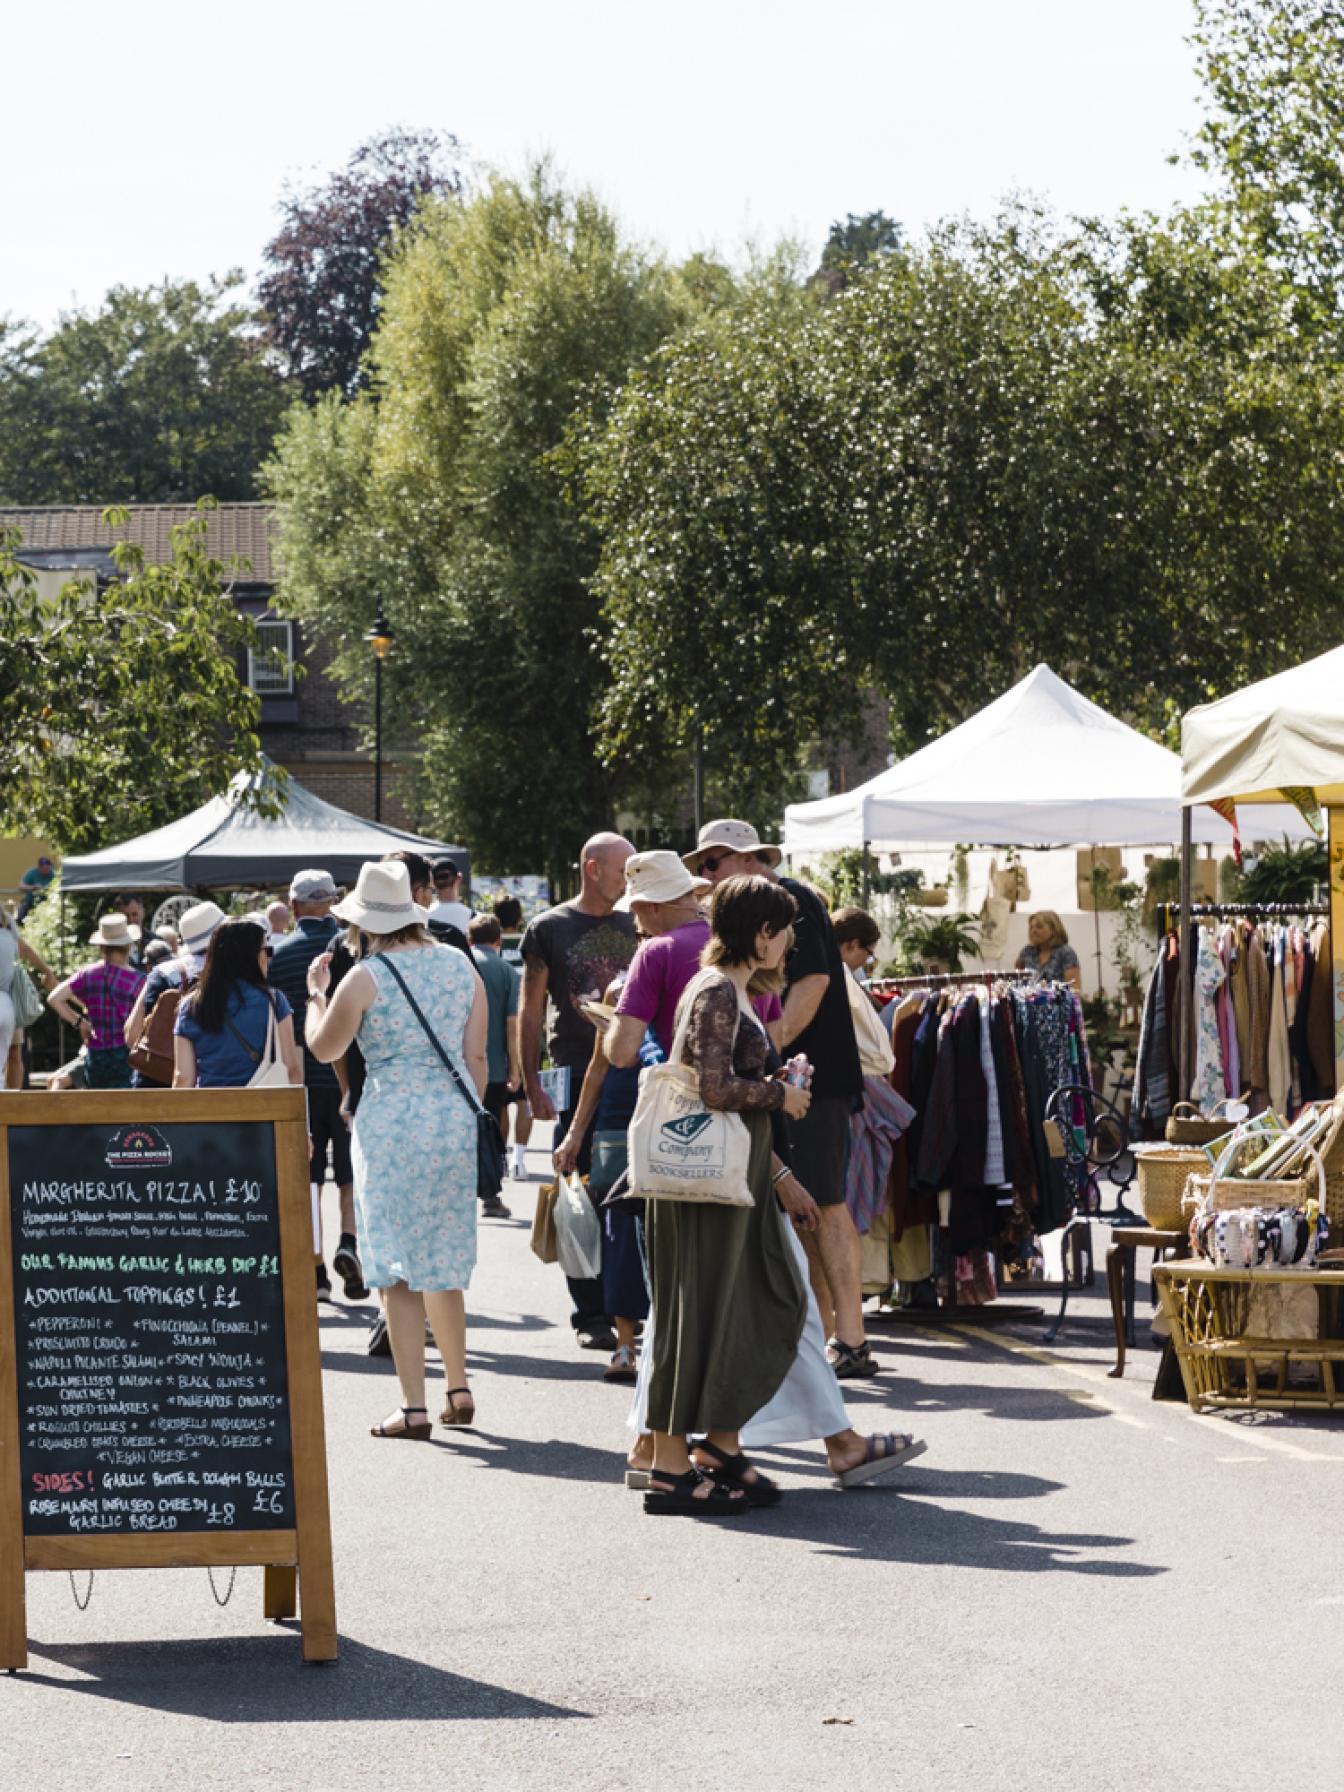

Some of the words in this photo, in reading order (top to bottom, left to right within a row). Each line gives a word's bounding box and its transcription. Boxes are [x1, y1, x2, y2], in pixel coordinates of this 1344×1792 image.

[658, 1141, 714, 1162] Company
[649, 1165, 725, 1179] BOOKSELLERS
[22, 1180, 141, 1204] MARGHERITA
[146, 1180, 217, 1206] PIZZA!
[225, 1178, 261, 1204] £10
[21, 1254, 55, 1270] OUR
[57, 1253, 115, 1271] FAMOUS
[119, 1256, 169, 1273] GARLIC
[187, 1257, 226, 1274] HERB
[232, 1257, 257, 1274] DIP
[257, 1254, 279, 1277] £1
[24, 1286, 121, 1308] ADDITIONAL
[123, 1285, 207, 1308] TOPPINGS!
[213, 1285, 241, 1308] £1
[37, 1317, 101, 1330] PEPPERONI
[93, 1337, 128, 1350] CRUDO
[173, 1334, 217, 1346] SALAMI
[34, 1356, 73, 1370] NAPOLI
[75, 1355, 121, 1369] PICANTE
[122, 1355, 157, 1369] SALAMI
[175, 1353, 204, 1368] SPICY
[36, 1375, 113, 1388] CARAMELISED
[118, 1375, 153, 1387] ONION
[178, 1375, 211, 1389] BLACK
[216, 1375, 254, 1388] OLIVES
[177, 1395, 233, 1408] PINEAPPLE
[238, 1395, 276, 1409] CHUNKS
[35, 1404, 57, 1417] SUN
[61, 1403, 94, 1417] DRIED
[84, 1420, 126, 1433] CHILLIES
[182, 1434, 216, 1449] EXTRA
[220, 1435, 261, 1448] CHEESE
[106, 1452, 146, 1466] VEGAN
[149, 1451, 189, 1464] CHEESE
[32, 1470, 96, 1493] SIDES!
[102, 1473, 147, 1490] GARLIC
[152, 1472, 199, 1487] BUTTER
[202, 1473, 241, 1488] DOUGH
[245, 1472, 285, 1488] BALLS
[252, 1490, 284, 1514] £6
[29, 1499, 98, 1516] ROSEMARY
[102, 1499, 154, 1513] INFUSED
[158, 1499, 207, 1513] CHEESY
[207, 1503, 235, 1525] £8
[69, 1515, 122, 1531] GARLIC
[129, 1515, 178, 1530] BREAD
